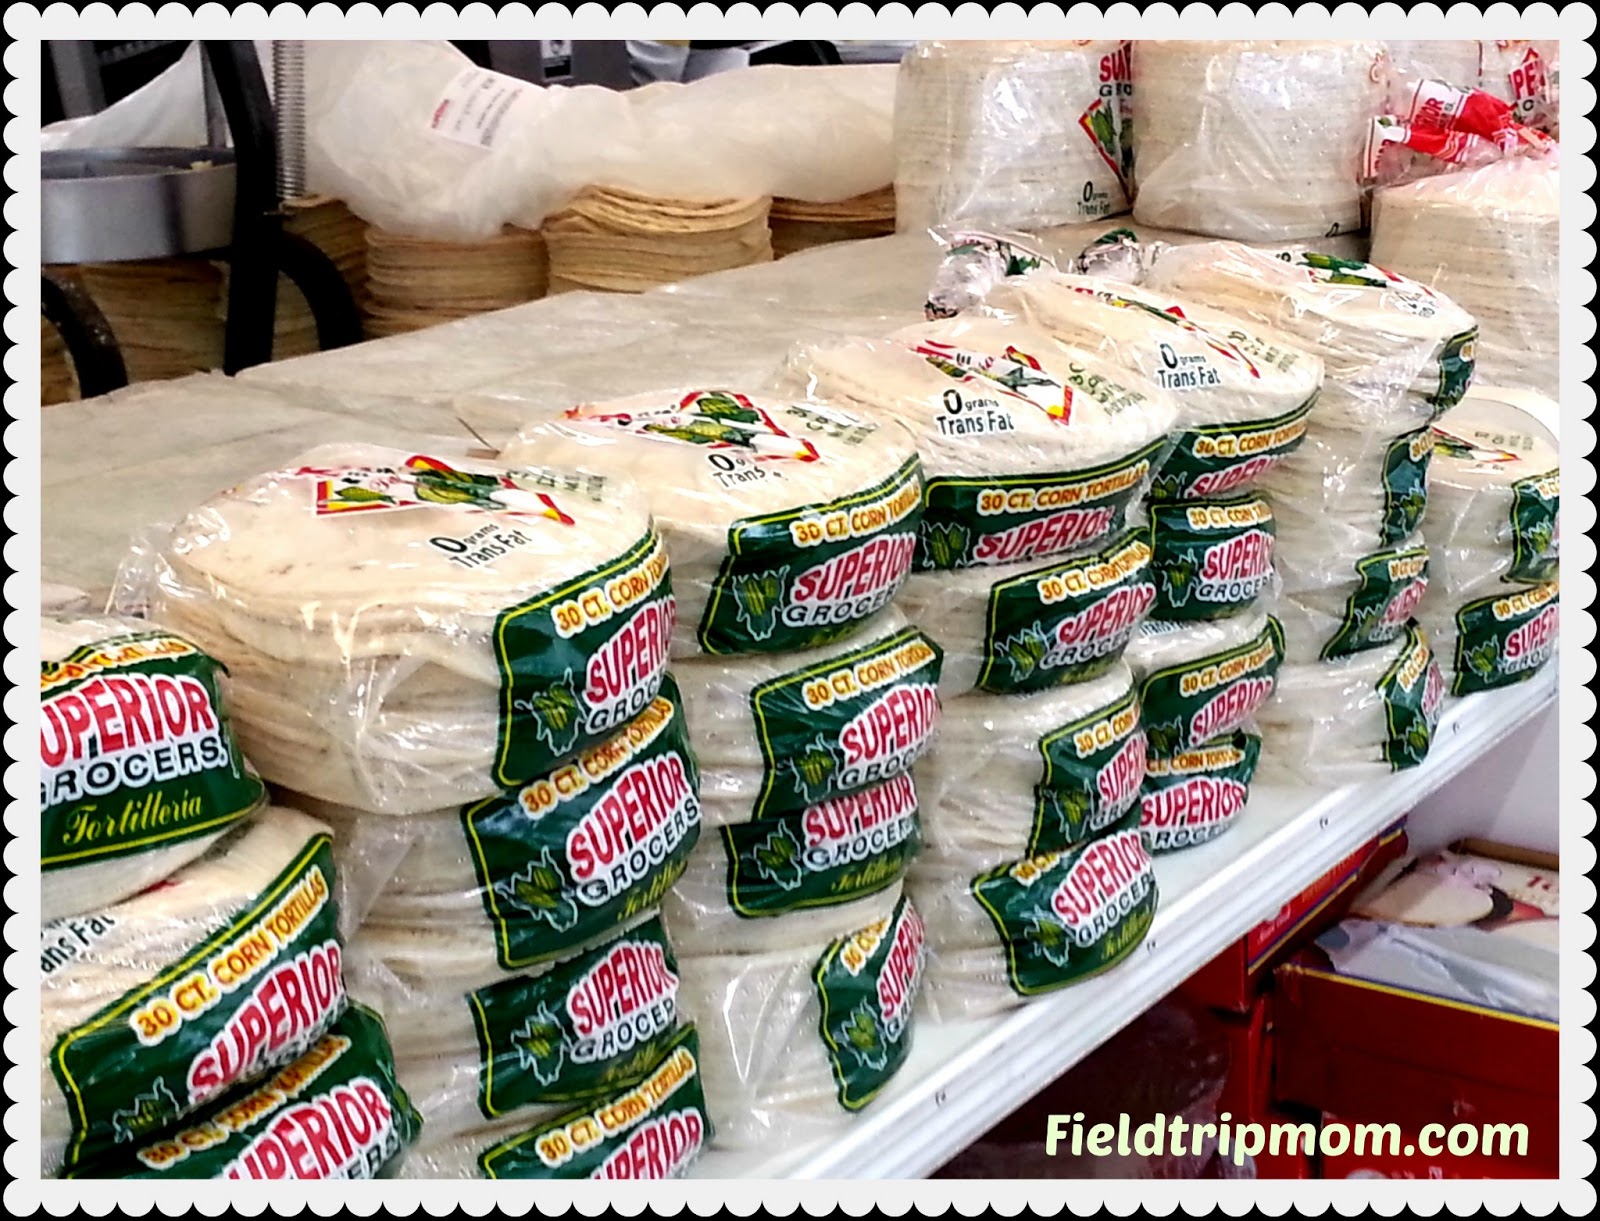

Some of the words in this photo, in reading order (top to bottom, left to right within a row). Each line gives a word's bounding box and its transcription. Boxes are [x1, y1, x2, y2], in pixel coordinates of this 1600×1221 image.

[1157, 369, 1197, 388] Trans
[1199, 367, 1221, 386] Fat
[1160, 343, 1178, 369] 0
[937, 414, 983, 436] Trans
[987, 411, 1015, 432] Fat
[943, 389, 962, 415] 0
[707, 453, 735, 473] 0
[712, 466, 767, 487] Trans
[980, 493, 1003, 511] 30
[1007, 493, 1032, 510] CT.
[1036, 488, 1082, 507] CORN
[429, 536, 468, 553] 0
[794, 522, 821, 543] 30
[851, 506, 887, 532] CORN
[976, 507, 1115, 560] SUPERIOR
[449, 541, 507, 569] Trans
[498, 529, 534, 554] Fat
[793, 535, 915, 603] SUPERIOR
[555, 606, 582, 632] 30
[582, 594, 611, 621] CT.
[608, 573, 650, 607] CORN
[1041, 582, 1062, 601] 30
[805, 684, 829, 706] 30
[830, 675, 857, 697] CT.
[856, 659, 897, 687] CORN
[1182, 677, 1198, 693] 30
[1219, 659, 1246, 681] CORN
[41, 677, 215, 768] UPERIOR
[1075, 734, 1095, 754] 30
[521, 784, 556, 815] 30
[553, 770, 587, 797] CT.
[581, 742, 627, 778] CORN
[568, 756, 689, 880] SUPERIOR
[804, 774, 917, 848] SUPERIOR
[1139, 779, 1245, 829] SUPERIOR
[578, 798, 699, 902] GROCERS
[1054, 832, 1150, 926] SUPERIOR
[41, 936, 77, 973] ans
[136, 1003, 176, 1041] 30
[174, 982, 219, 1018] CT.
[210, 938, 277, 989] CORN
[264, 868, 329, 944] TORTILLAS
[571, 945, 678, 1036] SUPERIOR
[190, 944, 342, 1103] SUPERIOR
[538, 1131, 570, 1163] 30
[598, 1094, 648, 1131] CORN
